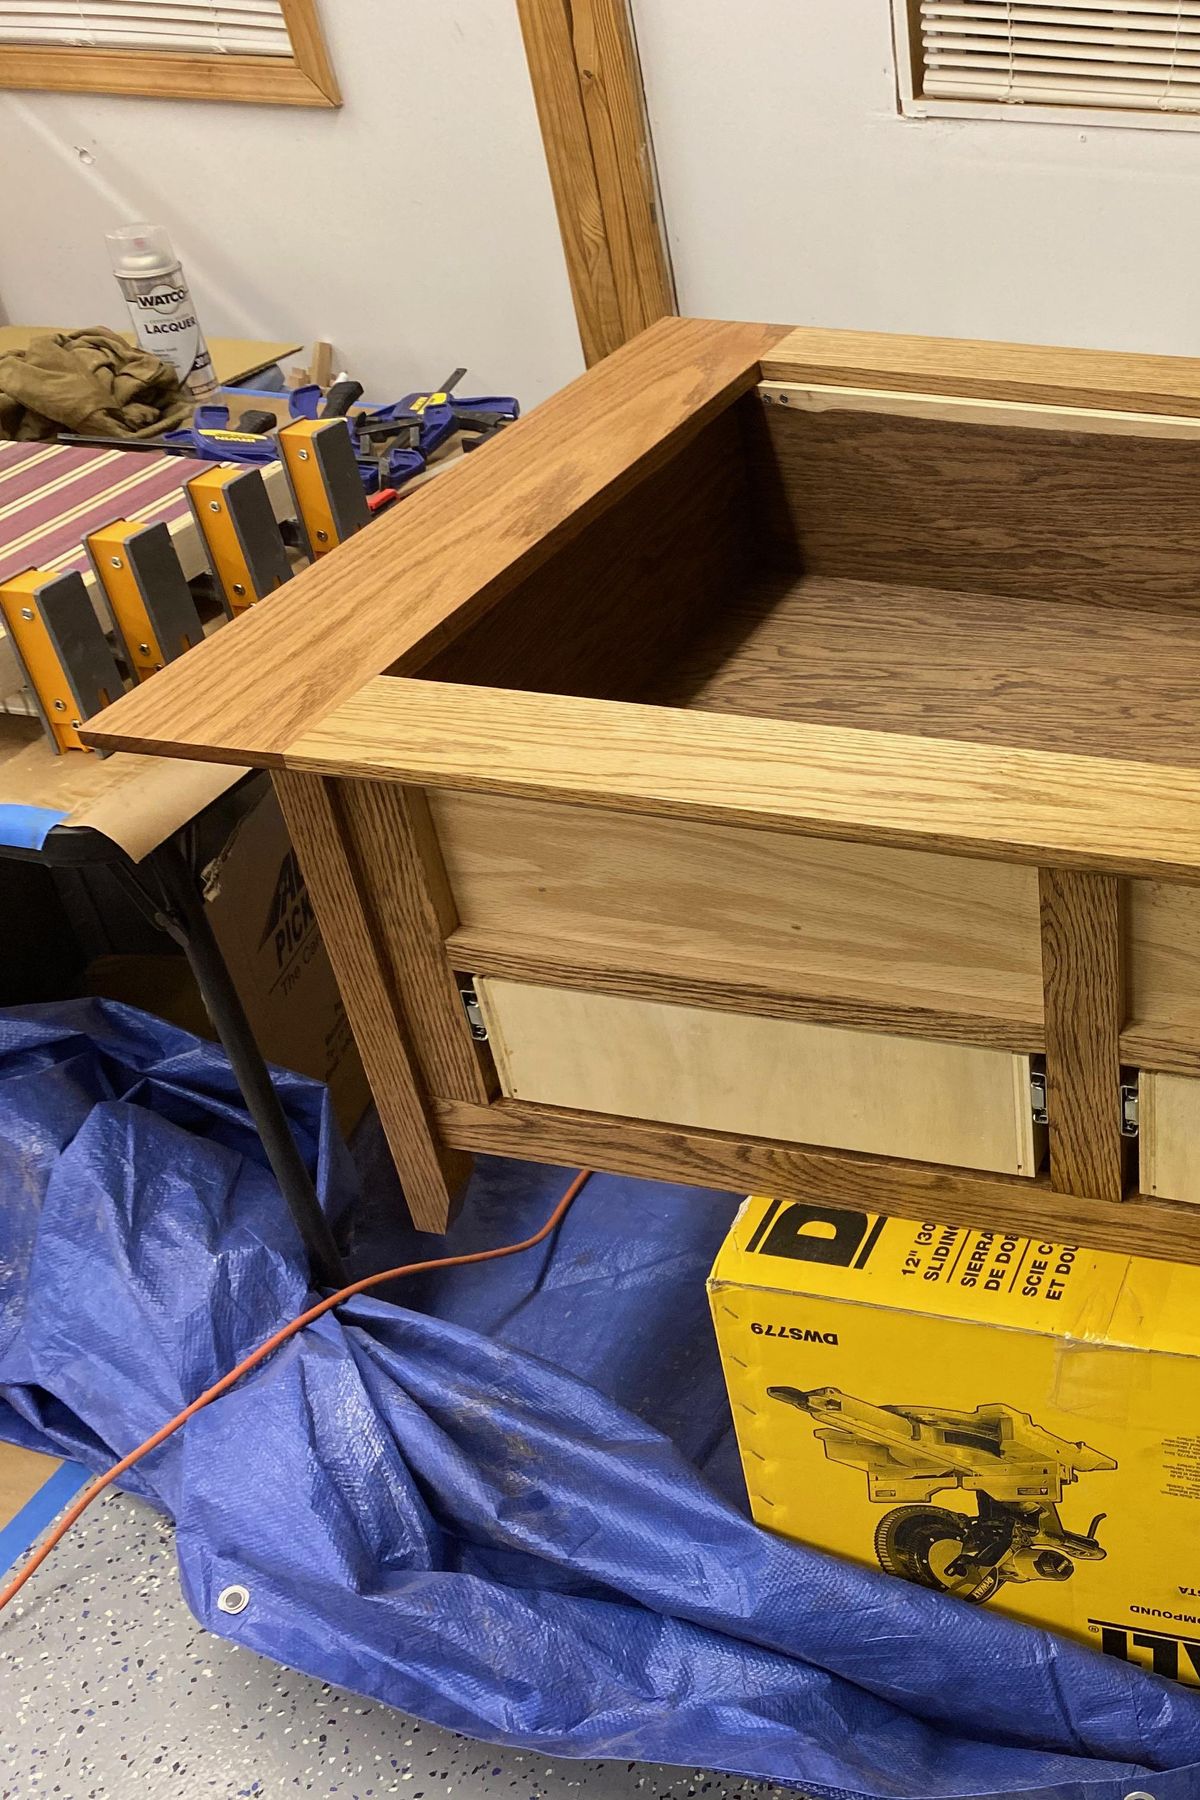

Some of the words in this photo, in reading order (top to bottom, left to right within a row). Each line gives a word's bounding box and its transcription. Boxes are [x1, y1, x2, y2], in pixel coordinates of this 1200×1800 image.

[138, 289, 186, 307] WATCO
[144, 316, 196, 335] LACQUER
[960, 1231, 994, 1287] SIERRA
[984, 1268, 1006, 1291] DE
[1022, 1260, 1048, 1297] SCIE
[1046, 1279, 1065, 1300] ET
[750, 1322, 839, 1345] DWS779
